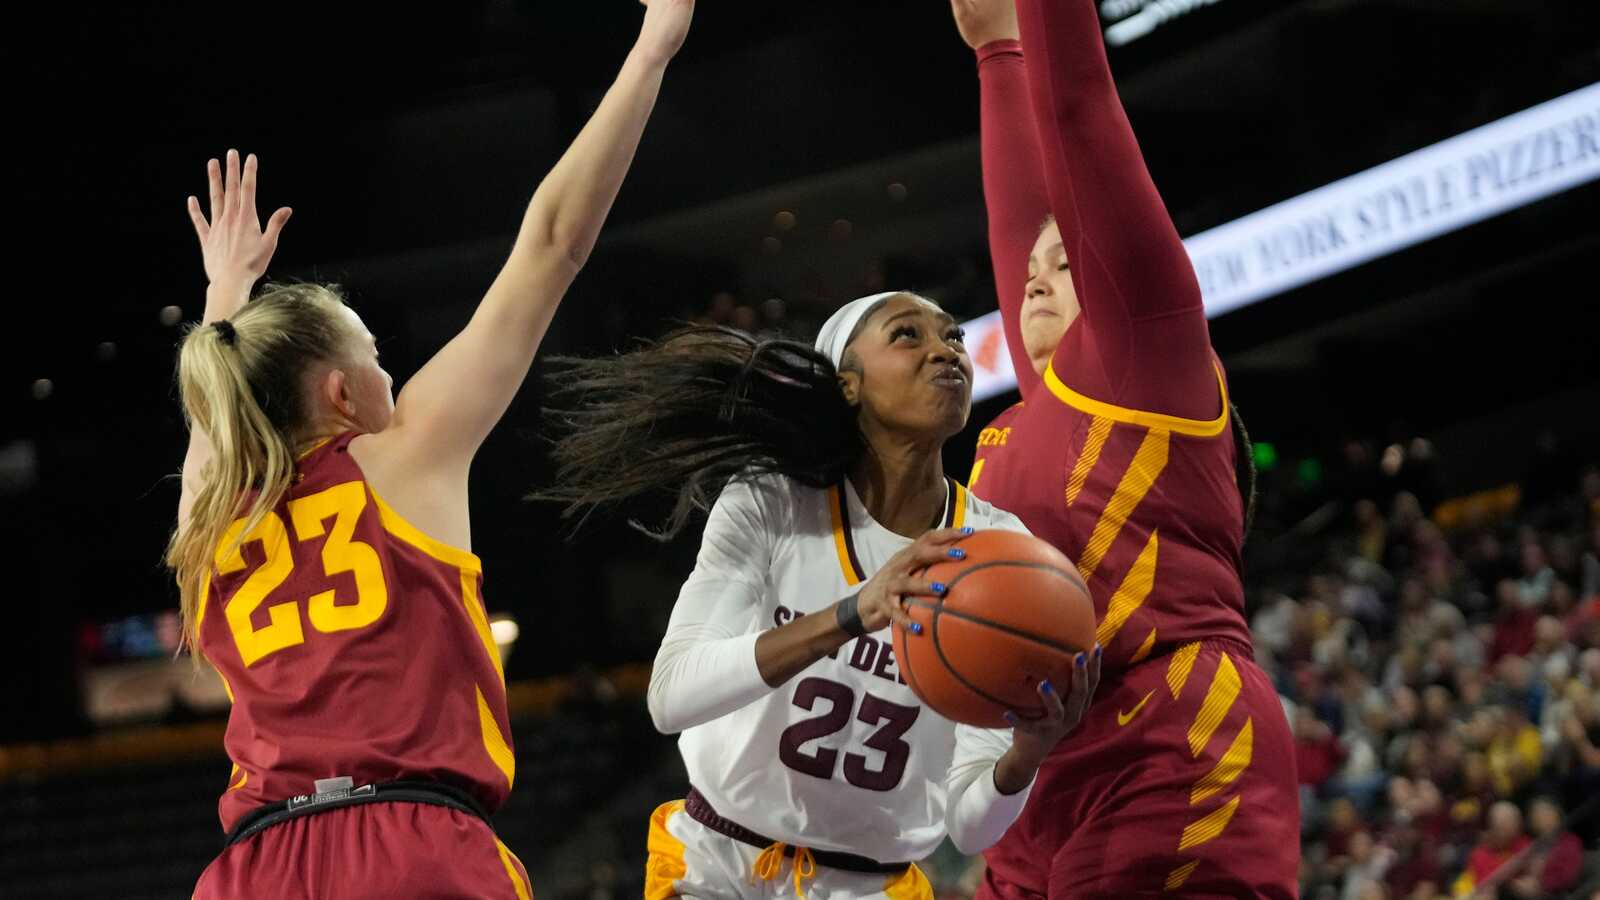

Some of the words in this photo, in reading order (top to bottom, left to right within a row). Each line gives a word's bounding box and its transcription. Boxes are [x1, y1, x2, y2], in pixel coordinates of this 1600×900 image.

[1197, 250, 1248, 294] EW
[1255, 205, 1349, 273] YORK
[1352, 163, 1462, 240] STYLE
[1463, 111, 1600, 199] PIZZER
[214, 480, 388, 668] 23
[779, 676, 920, 792] 23
